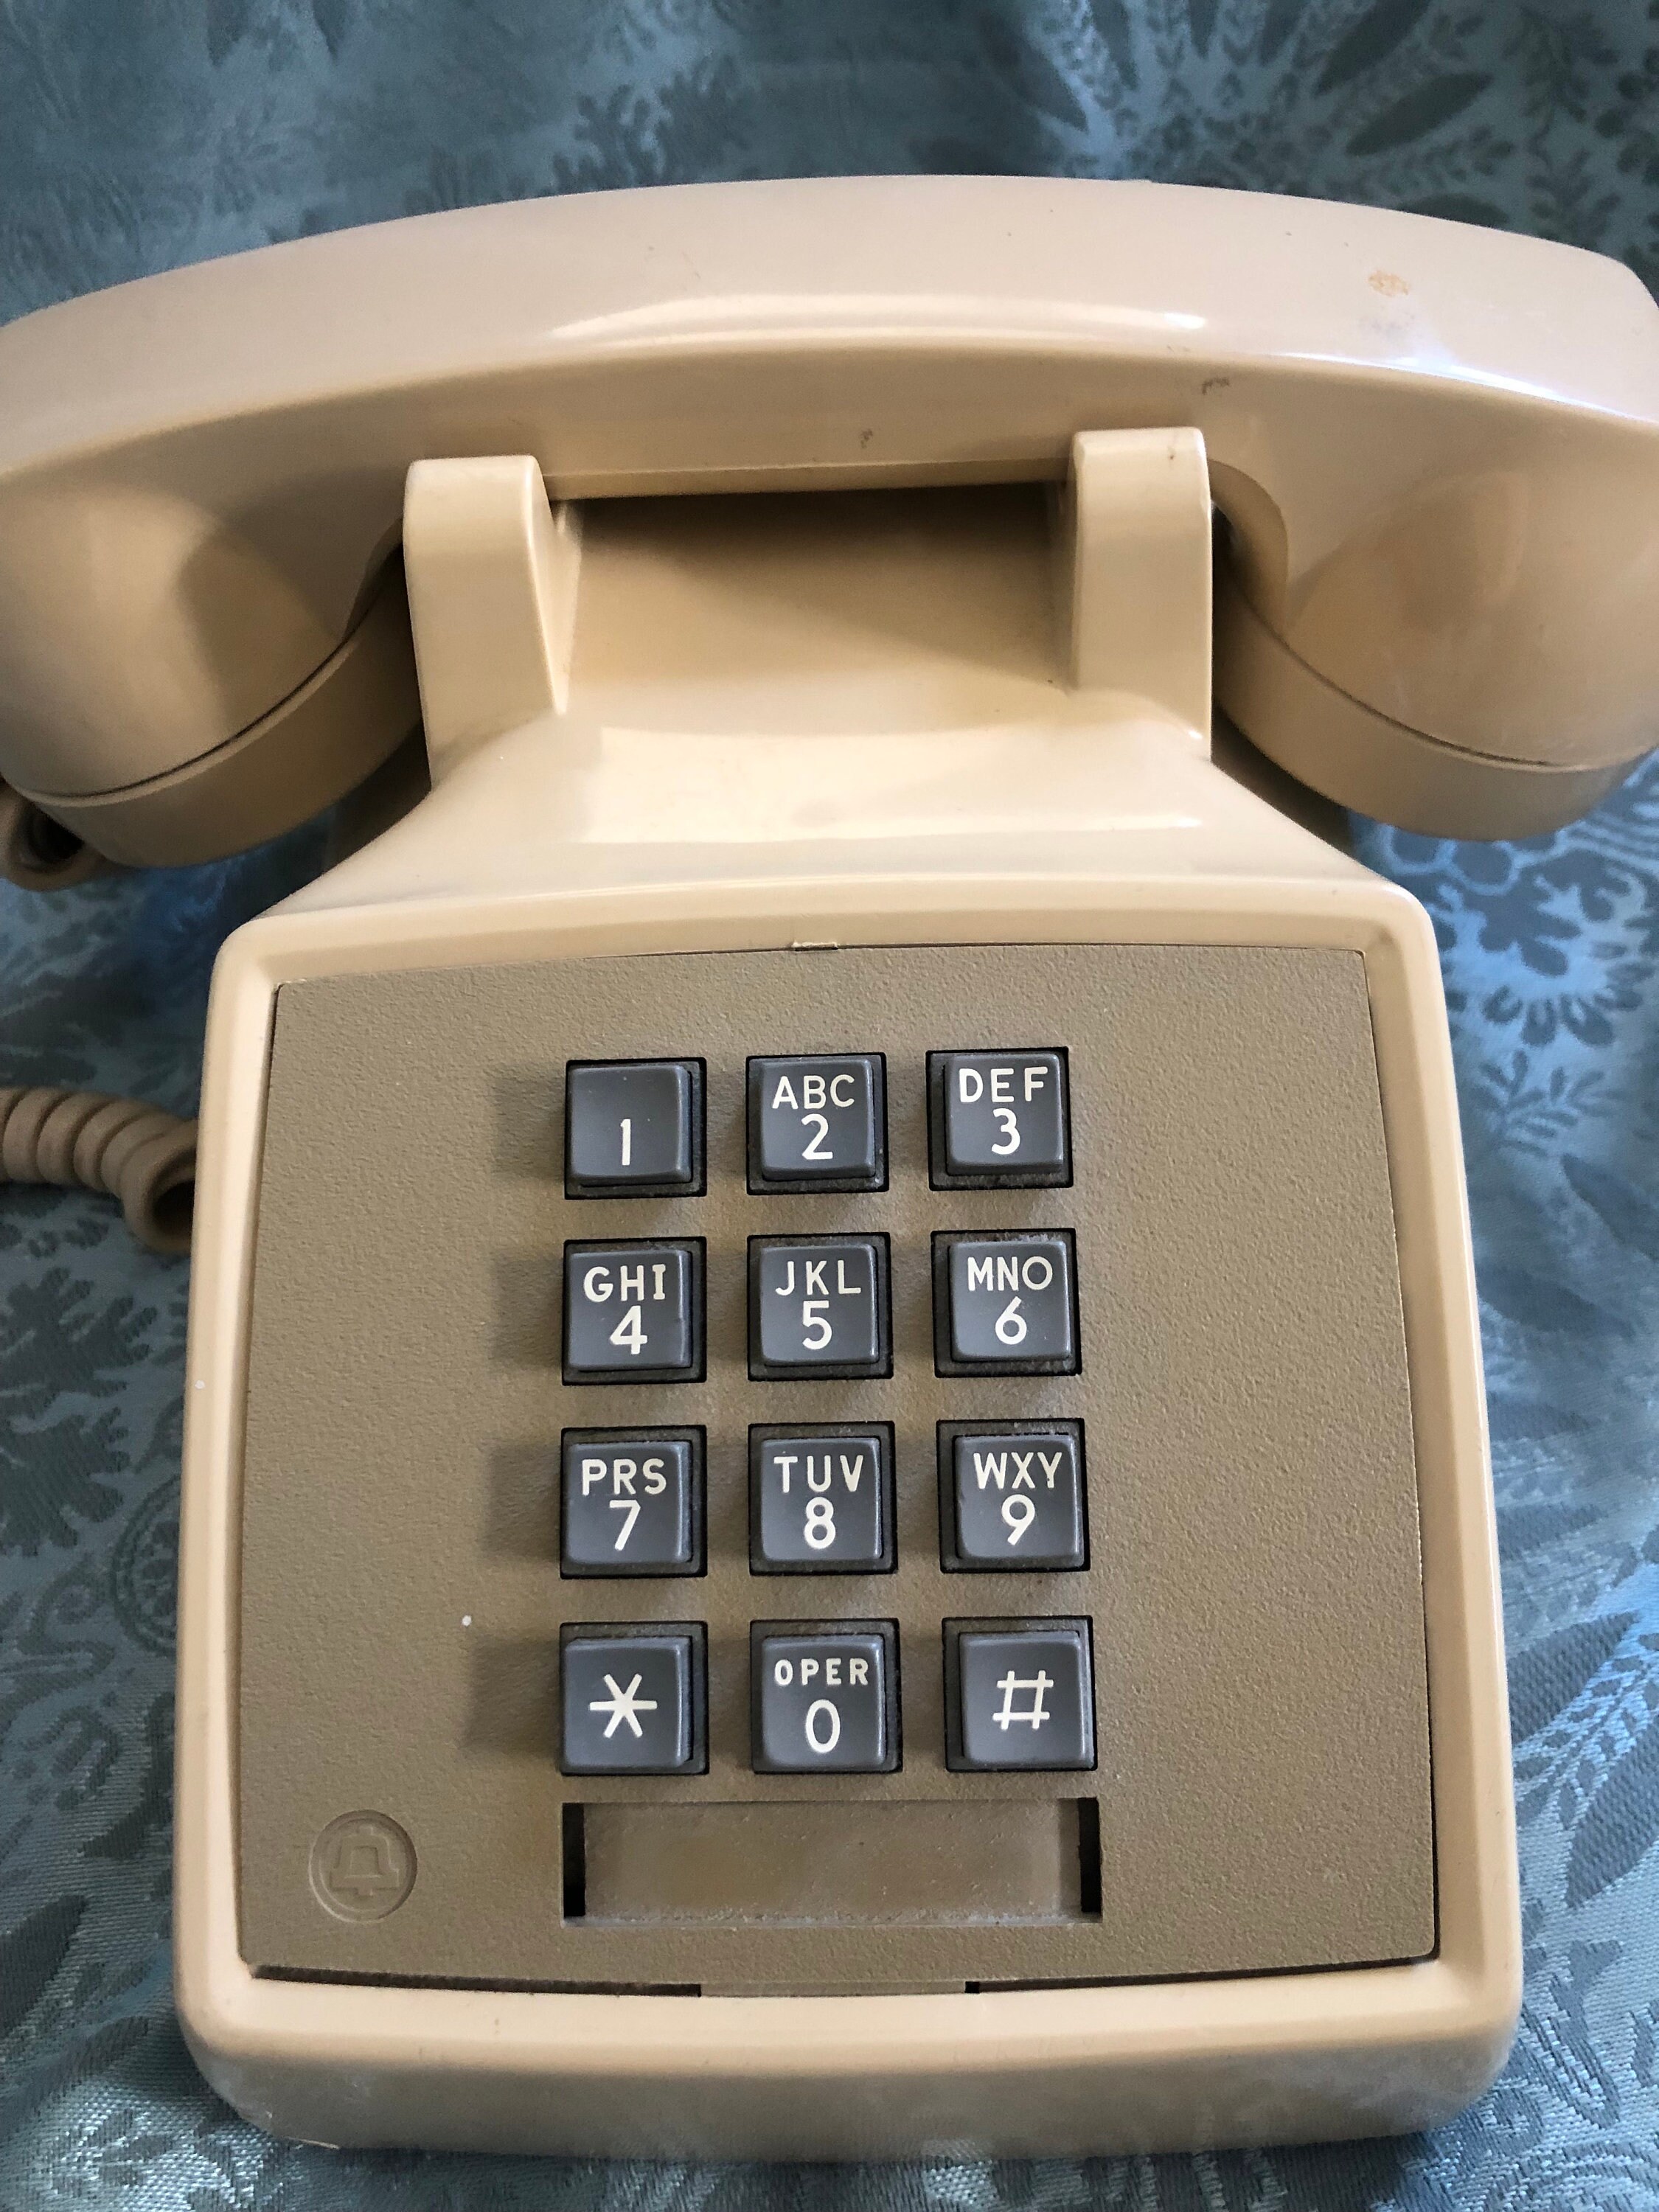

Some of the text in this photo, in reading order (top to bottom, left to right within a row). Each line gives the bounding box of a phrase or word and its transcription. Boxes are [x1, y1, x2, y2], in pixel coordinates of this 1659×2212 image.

[771, 1074, 855, 1110] ABC
[959, 1066, 1048, 1104] DEF
[620, 1119, 631, 1166] 1
[801, 1113, 833, 1161] 2
[991, 1107, 1020, 1155] 3
[583, 1264, 666, 1303] GHI
[775, 1259, 861, 1296] JKL
[967, 1256, 1053, 1292] MNO
[609, 1305, 648, 1355] 4
[801, 1300, 832, 1351] 5
[994, 1295, 1028, 1346] 6
[582, 1458, 667, 1497] PRS
[773, 1455, 863, 1494] TUV
[973, 1452, 1062, 1490] WXY
[609, 1499, 641, 1551] 7
[803, 1496, 836, 1551] 8
[1001, 1494, 1036, 1547] 9
[773, 1658, 869, 1687] OPER
[992, 1670, 1054, 1732] #
[804, 1699, 841, 1754] 0
